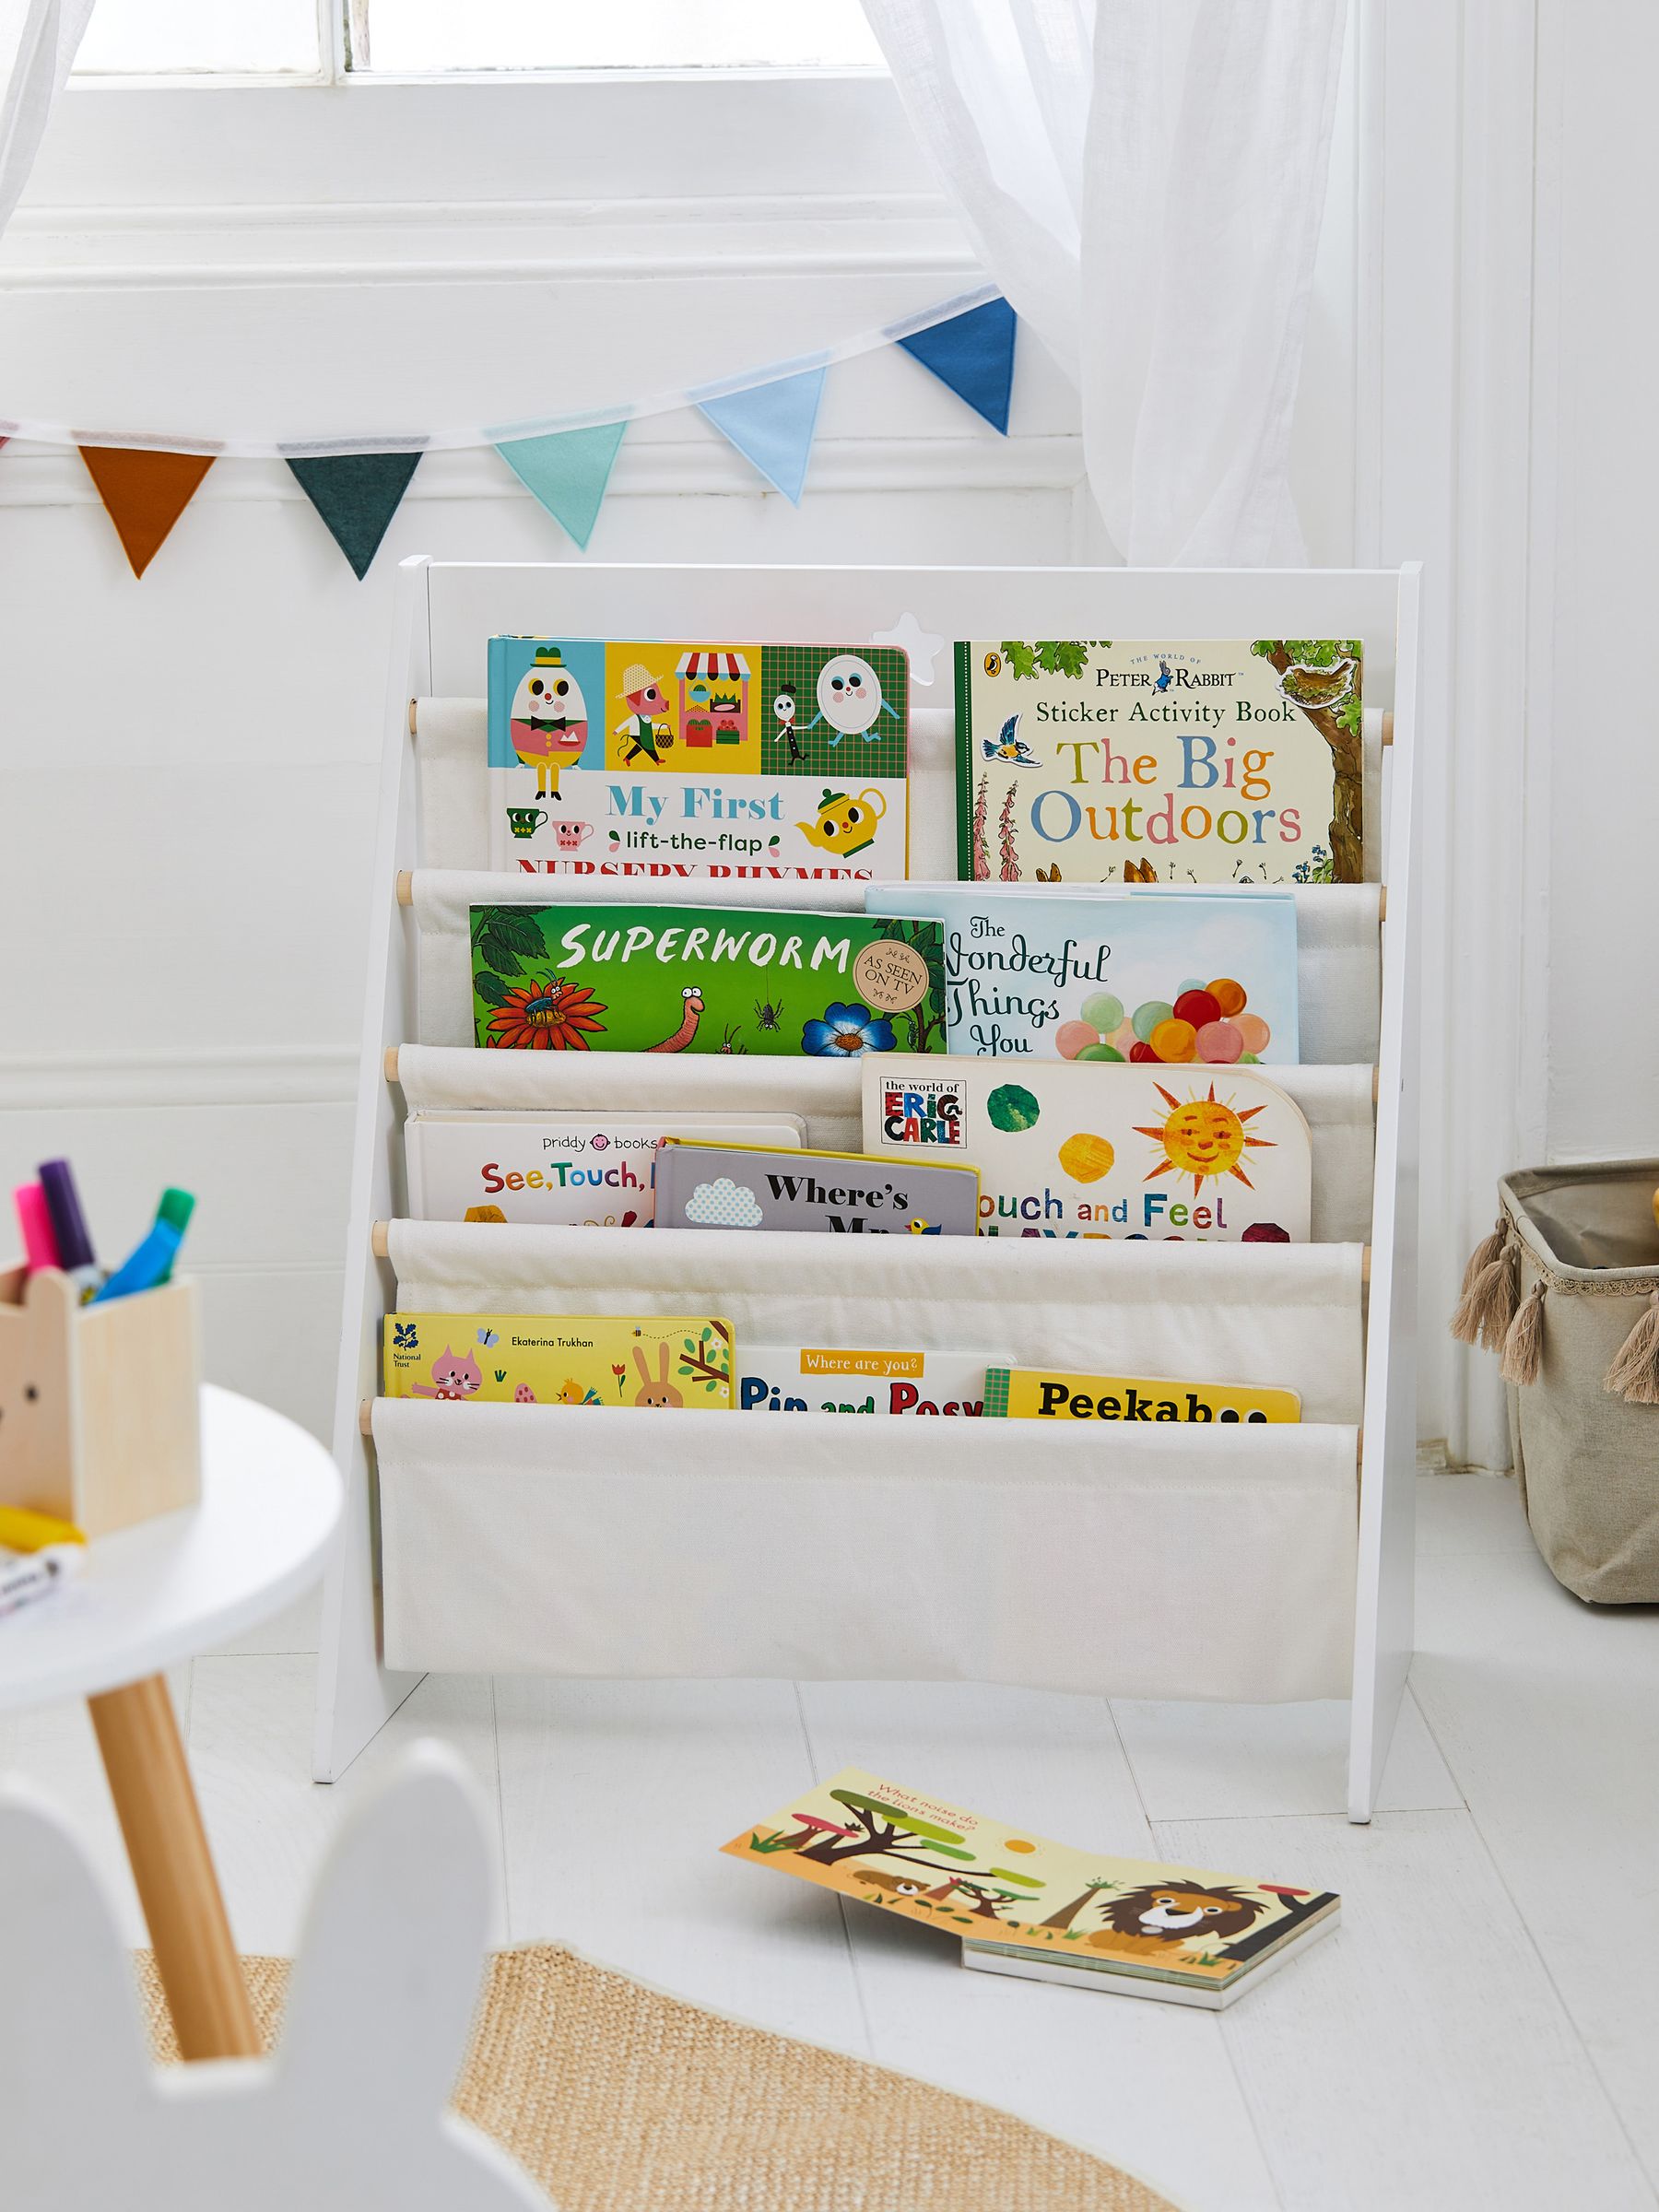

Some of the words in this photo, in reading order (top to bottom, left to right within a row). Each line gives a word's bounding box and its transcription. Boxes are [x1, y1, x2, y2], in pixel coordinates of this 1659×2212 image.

[1130, 655, 1148, 665] THE
[1096, 668, 1152, 687] PETER
[1175, 668, 1236, 689] RABBIT
[1036, 701, 1119, 723] Sticker
[1127, 701, 1226, 728] Activity
[1235, 701, 1297, 722] Book
[1056, 737, 1158, 784] The
[1176, 735, 1275, 801] Big
[605, 784, 669, 826] My
[679, 787, 785, 820] First
[1030, 790, 1301, 845] Outdoors
[626, 831, 763, 856] lift-the-flap
[970, 915, 1006, 938] The
[556, 923, 851, 973] SUPERWORM
[864, 956, 883, 969] AS
[885, 963, 923, 984] SEEN
[865, 969, 890, 986] ON
[894, 978, 914, 994] TV
[970, 1024, 1033, 1056] You
[886, 1080, 905, 1090] the
[909, 1082, 944, 1092] world
[947, 1084, 959, 1093] of
[884, 1115, 960, 1145] CARLE
[542, 1135, 586, 1153] priddy
[615, 1135, 658, 1149] books
[764, 1173, 909, 1210] Where's
[979, 1187, 1064, 1220] ouch
[1077, 1198, 1128, 1223] and
[1144, 1193, 1228, 1229] Feel
[512, 1336, 555, 1347] Ekaterina
[557, 1337, 594, 1347] Trukhan
[393, 1353, 421, 1361] National
[806, 1354, 851, 1370] Where
[854, 1359, 879, 1371] are
[883, 1358, 917, 1375] you?
[867, 1790, 890, 1802] the
[892, 1798, 926, 1816] lions
[929, 1813, 976, 1831] make?
[879, 1783, 918, 1802] What
[920, 1801, 957, 1818] noise
[959, 1815, 978, 1826] do
